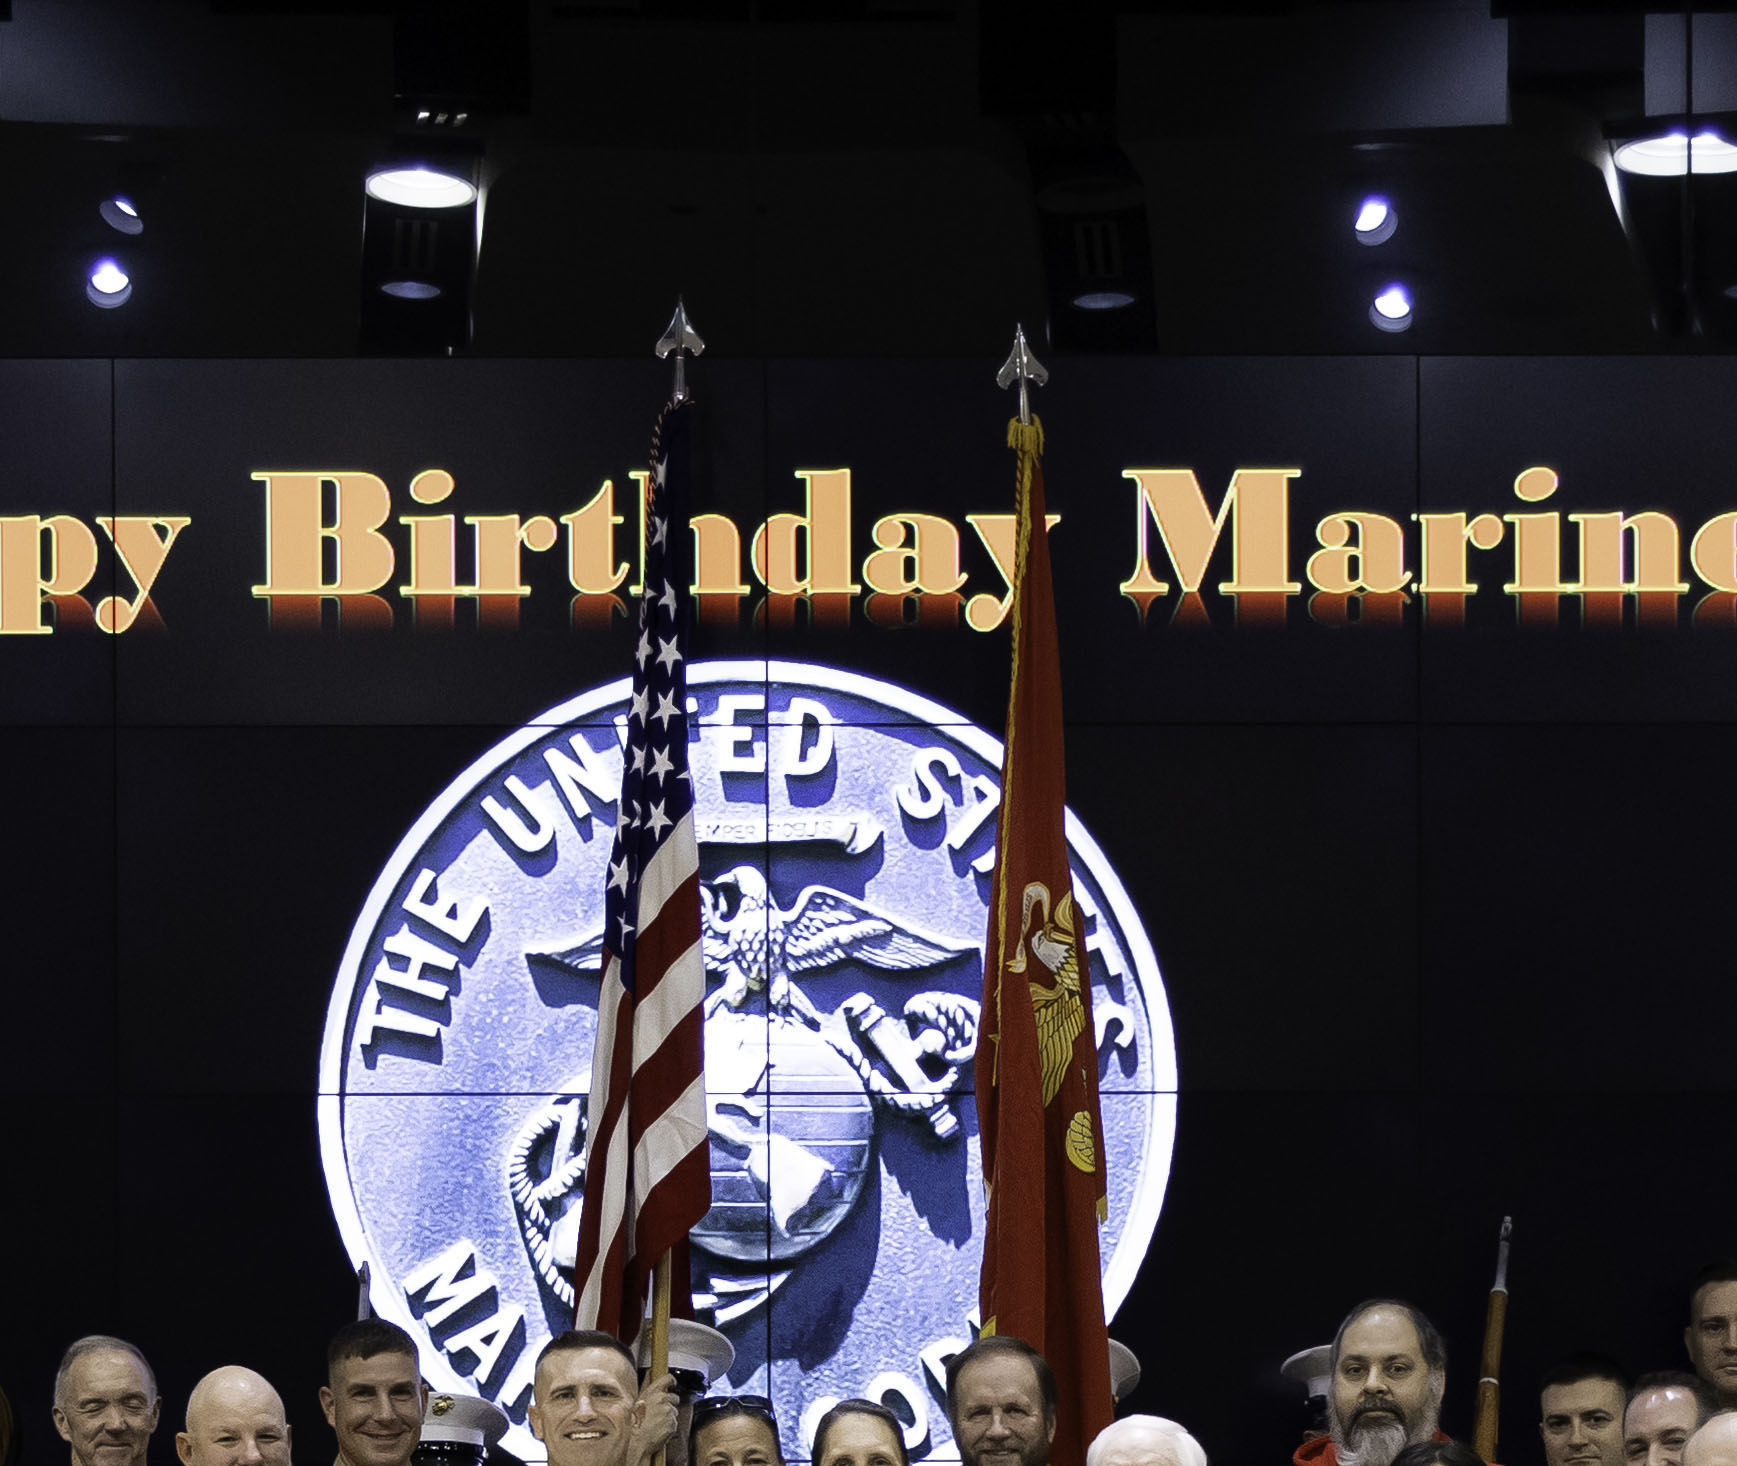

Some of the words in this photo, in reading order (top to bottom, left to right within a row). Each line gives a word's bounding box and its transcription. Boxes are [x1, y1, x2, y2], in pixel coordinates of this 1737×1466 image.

[251, 467, 1061, 632] Birthday
[358, 868, 491, 1046] THE
[480, 694, 834, 852] UNED
